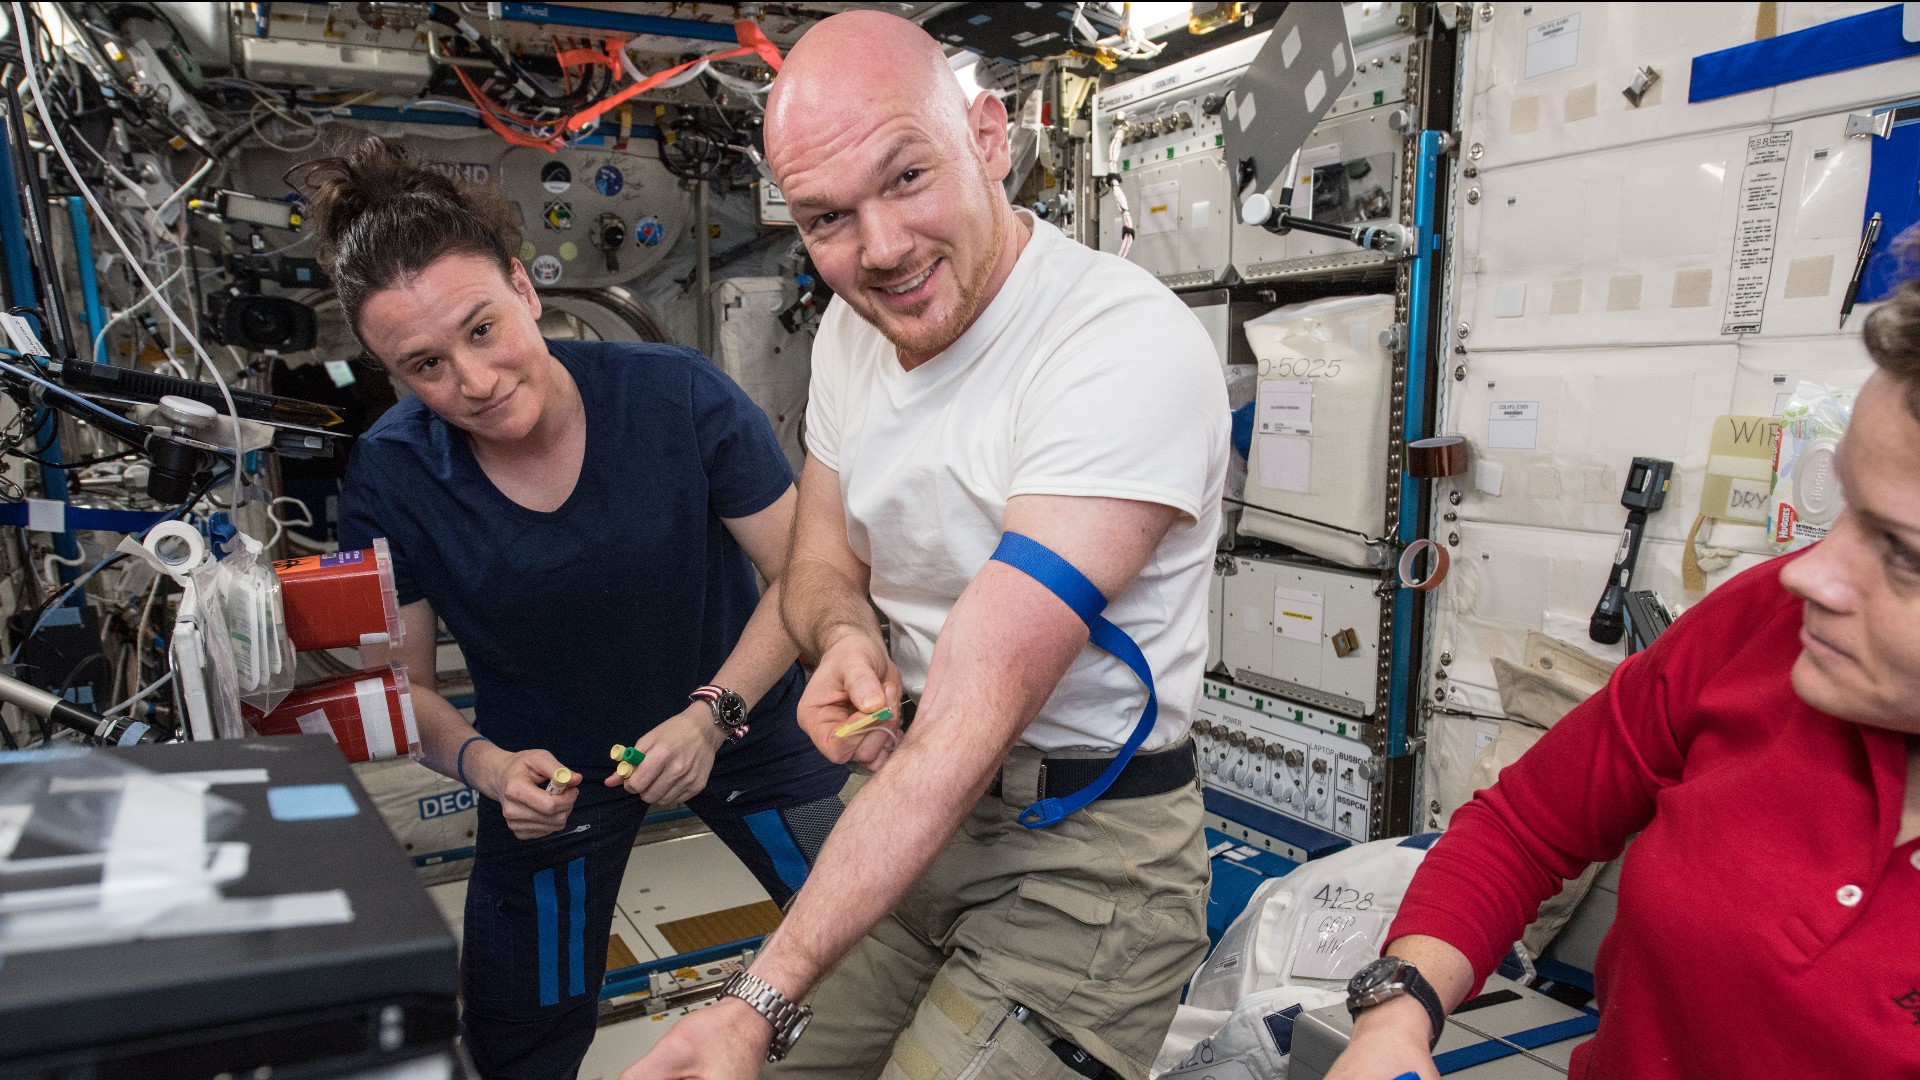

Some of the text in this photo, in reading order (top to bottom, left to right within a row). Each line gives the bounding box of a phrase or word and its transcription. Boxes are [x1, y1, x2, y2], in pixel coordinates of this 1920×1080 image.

[1730, 488, 1768, 509] DRY
[1777, 507, 1791, 539] HUGGIES
[1222, 714, 1242, 727] POWER
[1308, 743, 1335, 755] LAPTOP
[1336, 795, 1366, 812] BSSPCM
[1313, 883, 1375, 911] 4128
